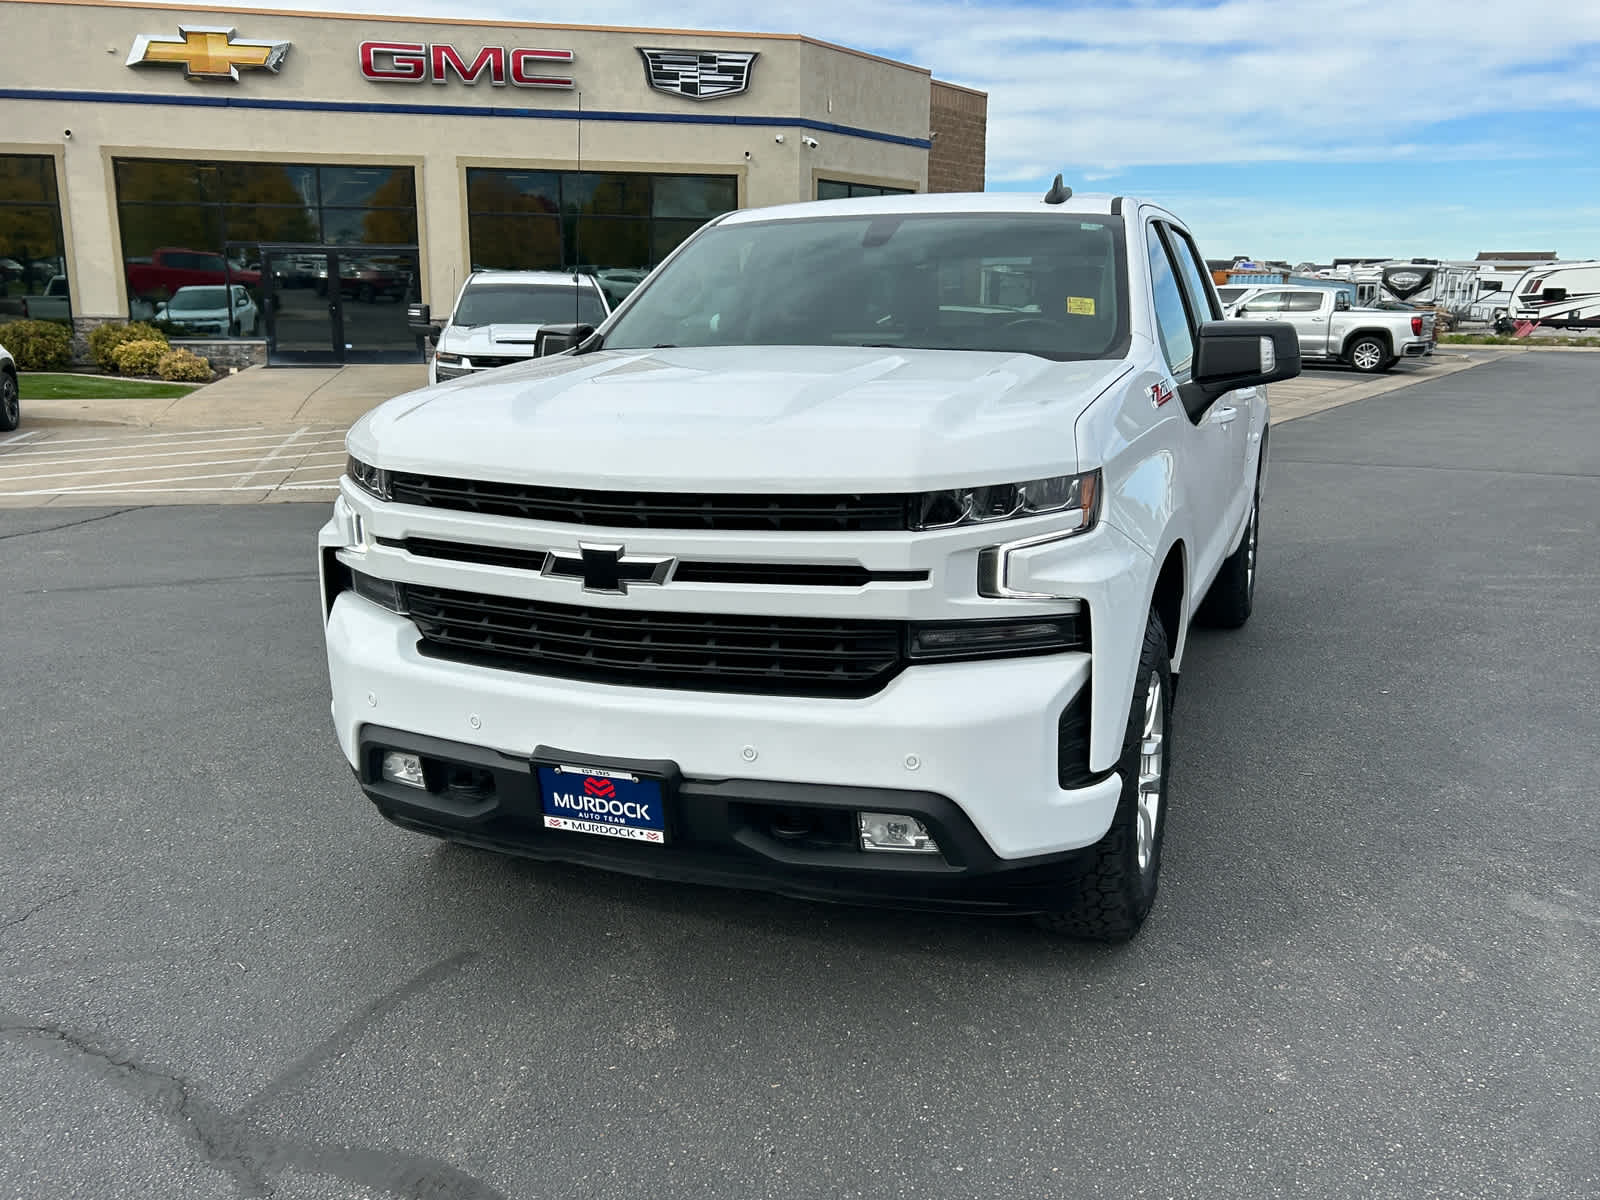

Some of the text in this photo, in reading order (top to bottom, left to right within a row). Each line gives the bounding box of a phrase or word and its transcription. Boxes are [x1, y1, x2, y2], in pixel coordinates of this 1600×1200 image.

[358, 40, 575, 90] GMC
[553, 792, 651, 820] MURDOCK
[578, 812, 626, 824] AUTO TEAM
[571, 821, 636, 838] MURDOCK
